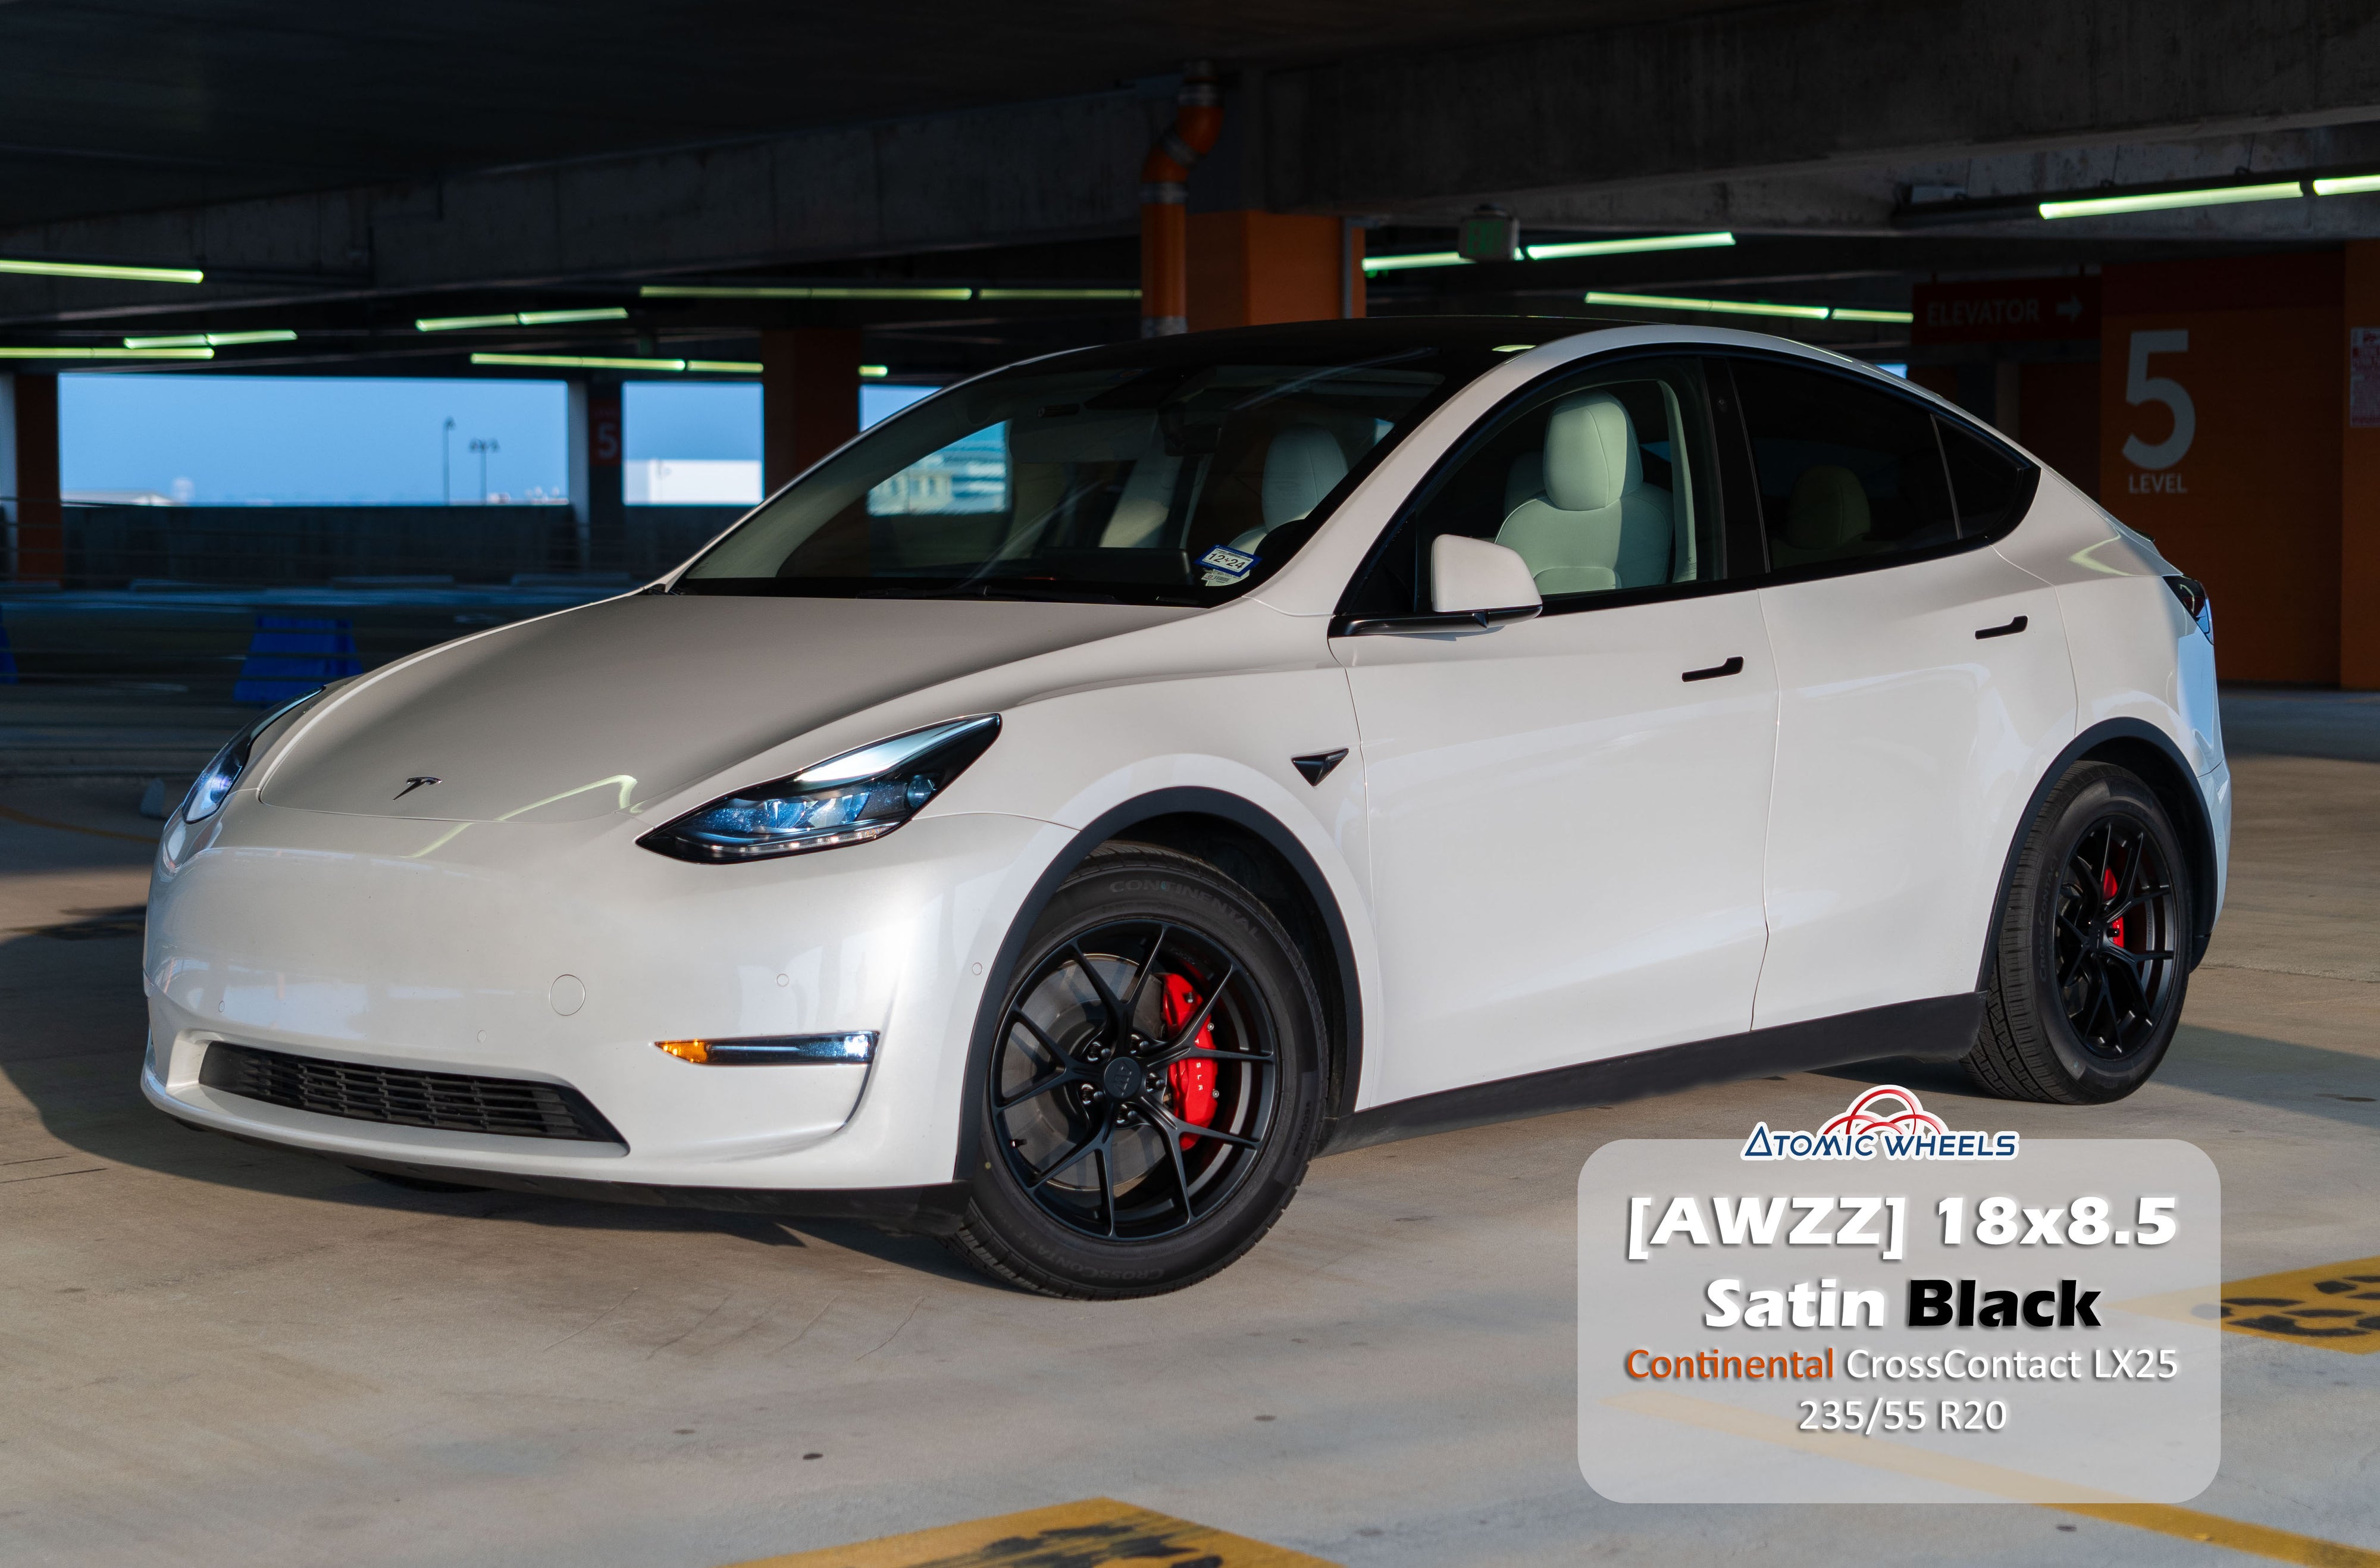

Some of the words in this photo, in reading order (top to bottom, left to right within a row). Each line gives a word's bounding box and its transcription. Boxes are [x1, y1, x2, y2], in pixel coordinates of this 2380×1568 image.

[1926, 298, 2040, 326] ELEVATOR
[2122, 328, 2196, 470] 5
[597, 422, 618, 459] 5
[2128, 474, 2188, 494] LEVEL
[1109, 880, 1258, 940] CONTINENTAL
[1194, 1038, 1204, 1091] TSLA
